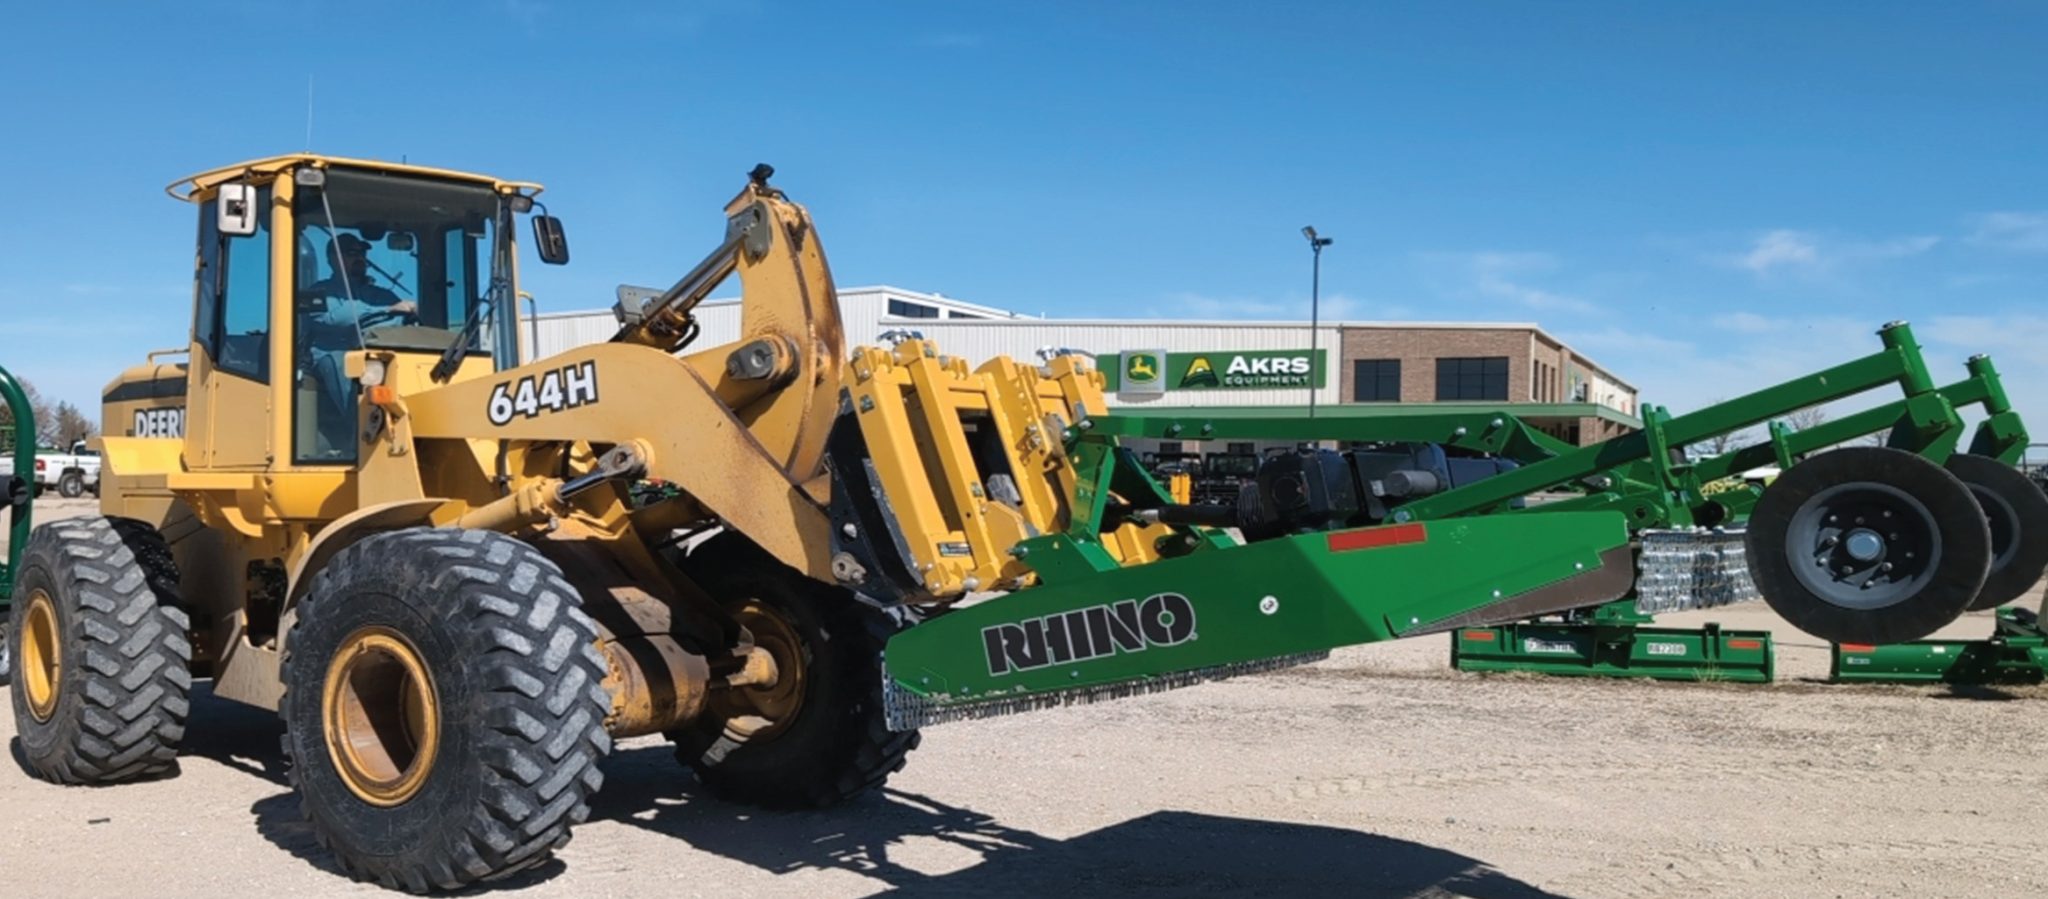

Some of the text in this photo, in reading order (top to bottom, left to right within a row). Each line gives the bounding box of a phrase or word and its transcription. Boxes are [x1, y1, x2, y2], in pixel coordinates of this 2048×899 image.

[1224, 375, 1310, 386] EQUIPMENT
[1226, 355, 1310, 375] AKRS
[487, 359, 598, 426] 644H
[981, 592, 1196, 677] RHINO
